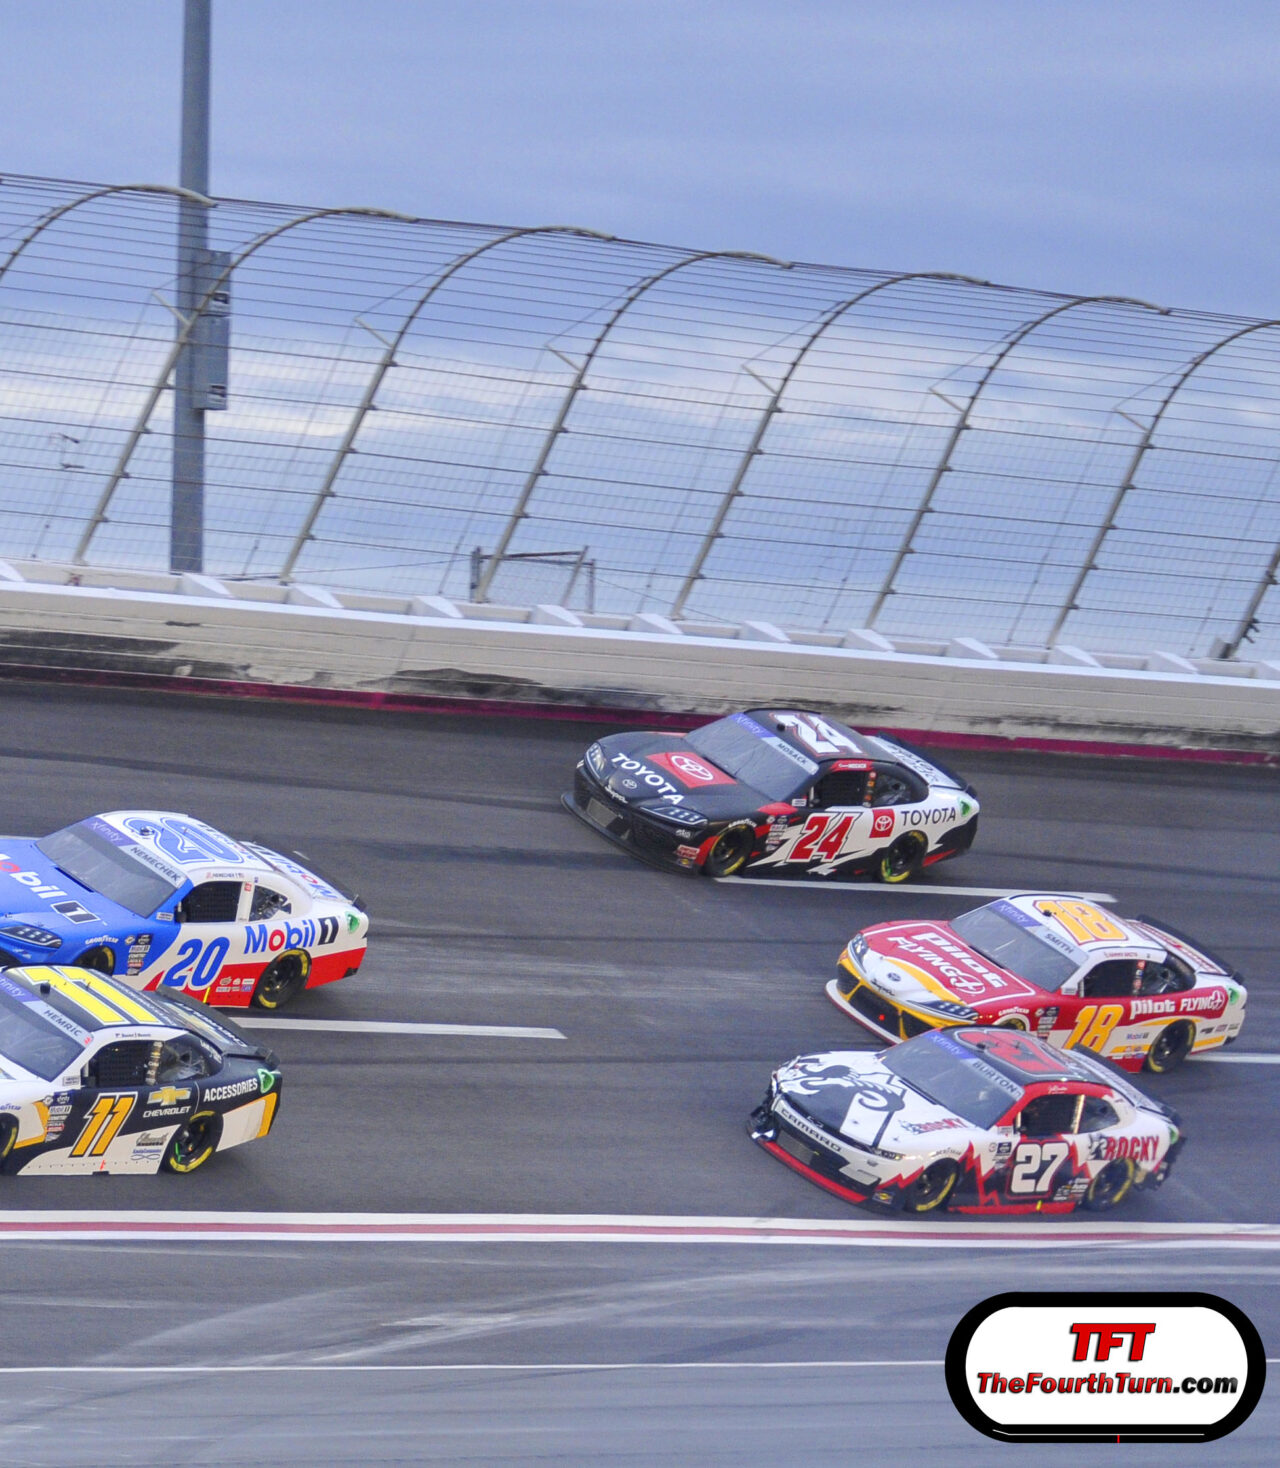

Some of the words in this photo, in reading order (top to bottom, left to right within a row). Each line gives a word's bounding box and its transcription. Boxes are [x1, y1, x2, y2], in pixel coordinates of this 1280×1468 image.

[772, 713, 865, 755] 24
[611, 753, 685, 805] TOYOTA
[787, 814, 858, 861] 24
[901, 808, 956, 826] TOYOTA
[129, 845, 182, 882] NEMECHEK
[243, 918, 316, 954] Mobil
[319, 917, 338, 944] 1
[1033, 900, 1129, 946] 18
[162, 936, 231, 990] 20
[21, 966, 162, 1024] 11
[43, 1009, 82, 1038] HEMRIC
[1064, 1004, 1124, 1053] 18
[203, 1077, 258, 1102] ACCESSORIES
[972, 1061, 1018, 1094] BURTON
[69, 1092, 138, 1157] 11
[142, 1105, 191, 1118] CHEVROLET
[781, 1107, 842, 1152] CAMARO
[1011, 1142, 1069, 1194] 27
[1105, 1135, 1160, 1161] ROCKY
